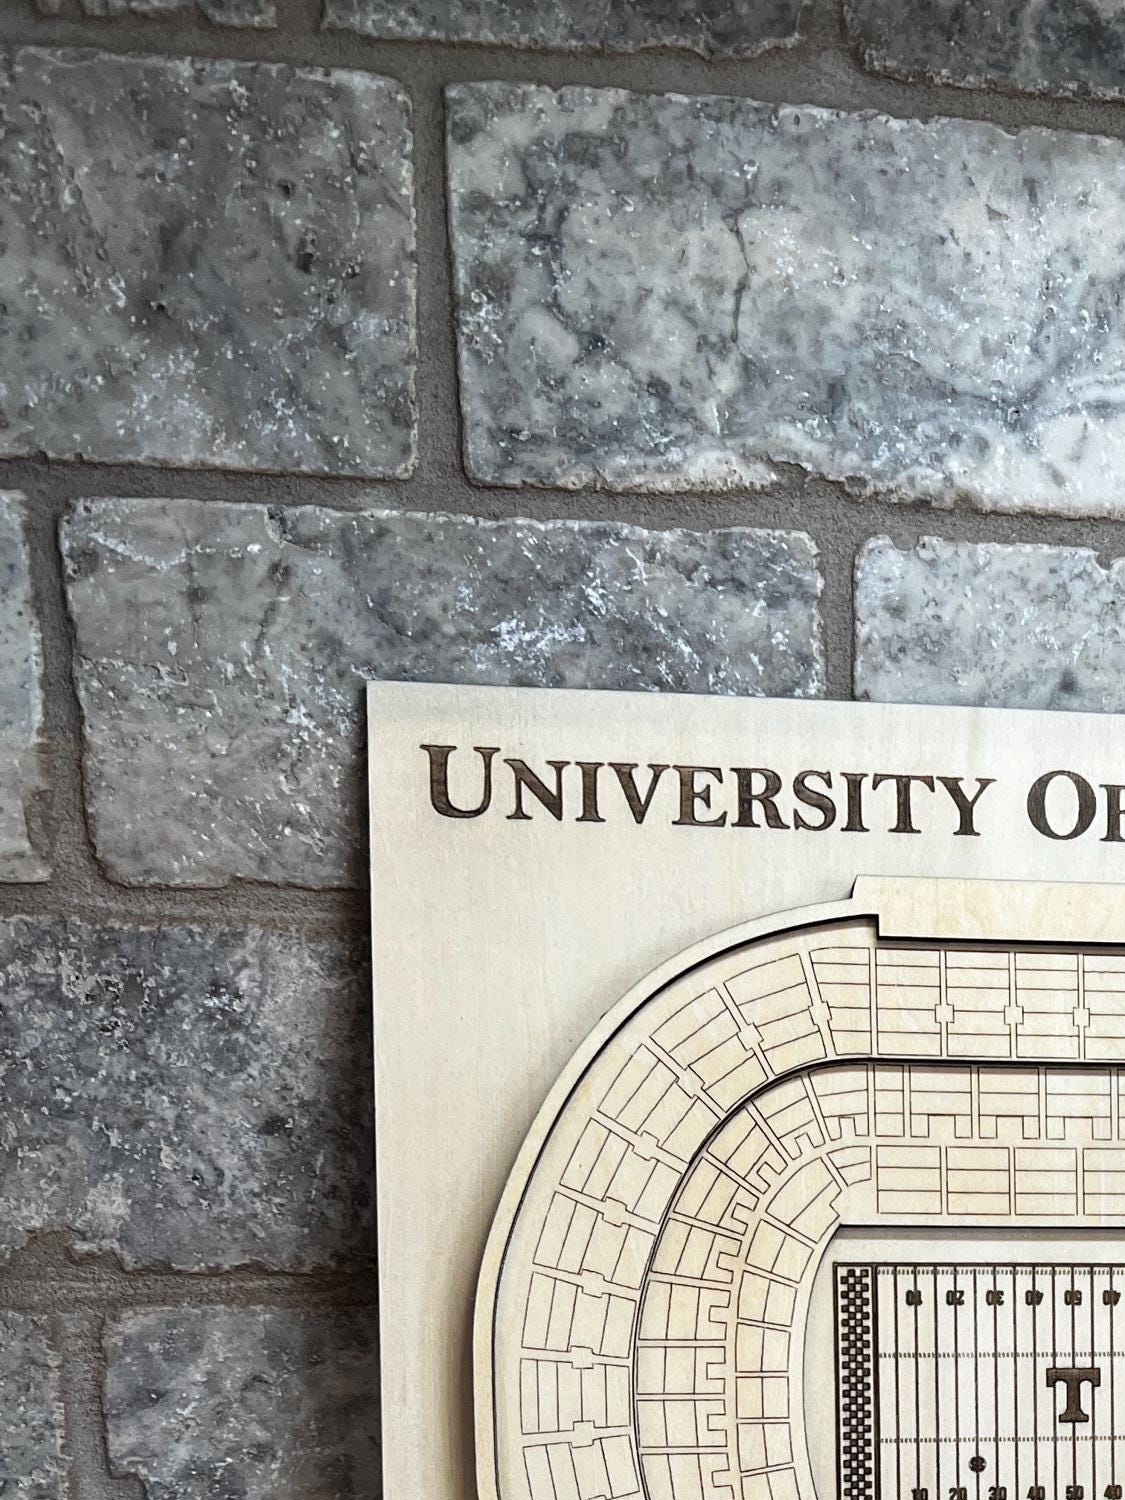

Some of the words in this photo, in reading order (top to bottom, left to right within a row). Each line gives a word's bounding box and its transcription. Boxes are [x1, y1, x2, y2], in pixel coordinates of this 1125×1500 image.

[420, 745, 996, 836] UNIVERSITY
[1046, 1367, 1101, 1423] T
[1066, 1485, 1084, 1500] 50
[1104, 1485, 1123, 1500] 40
